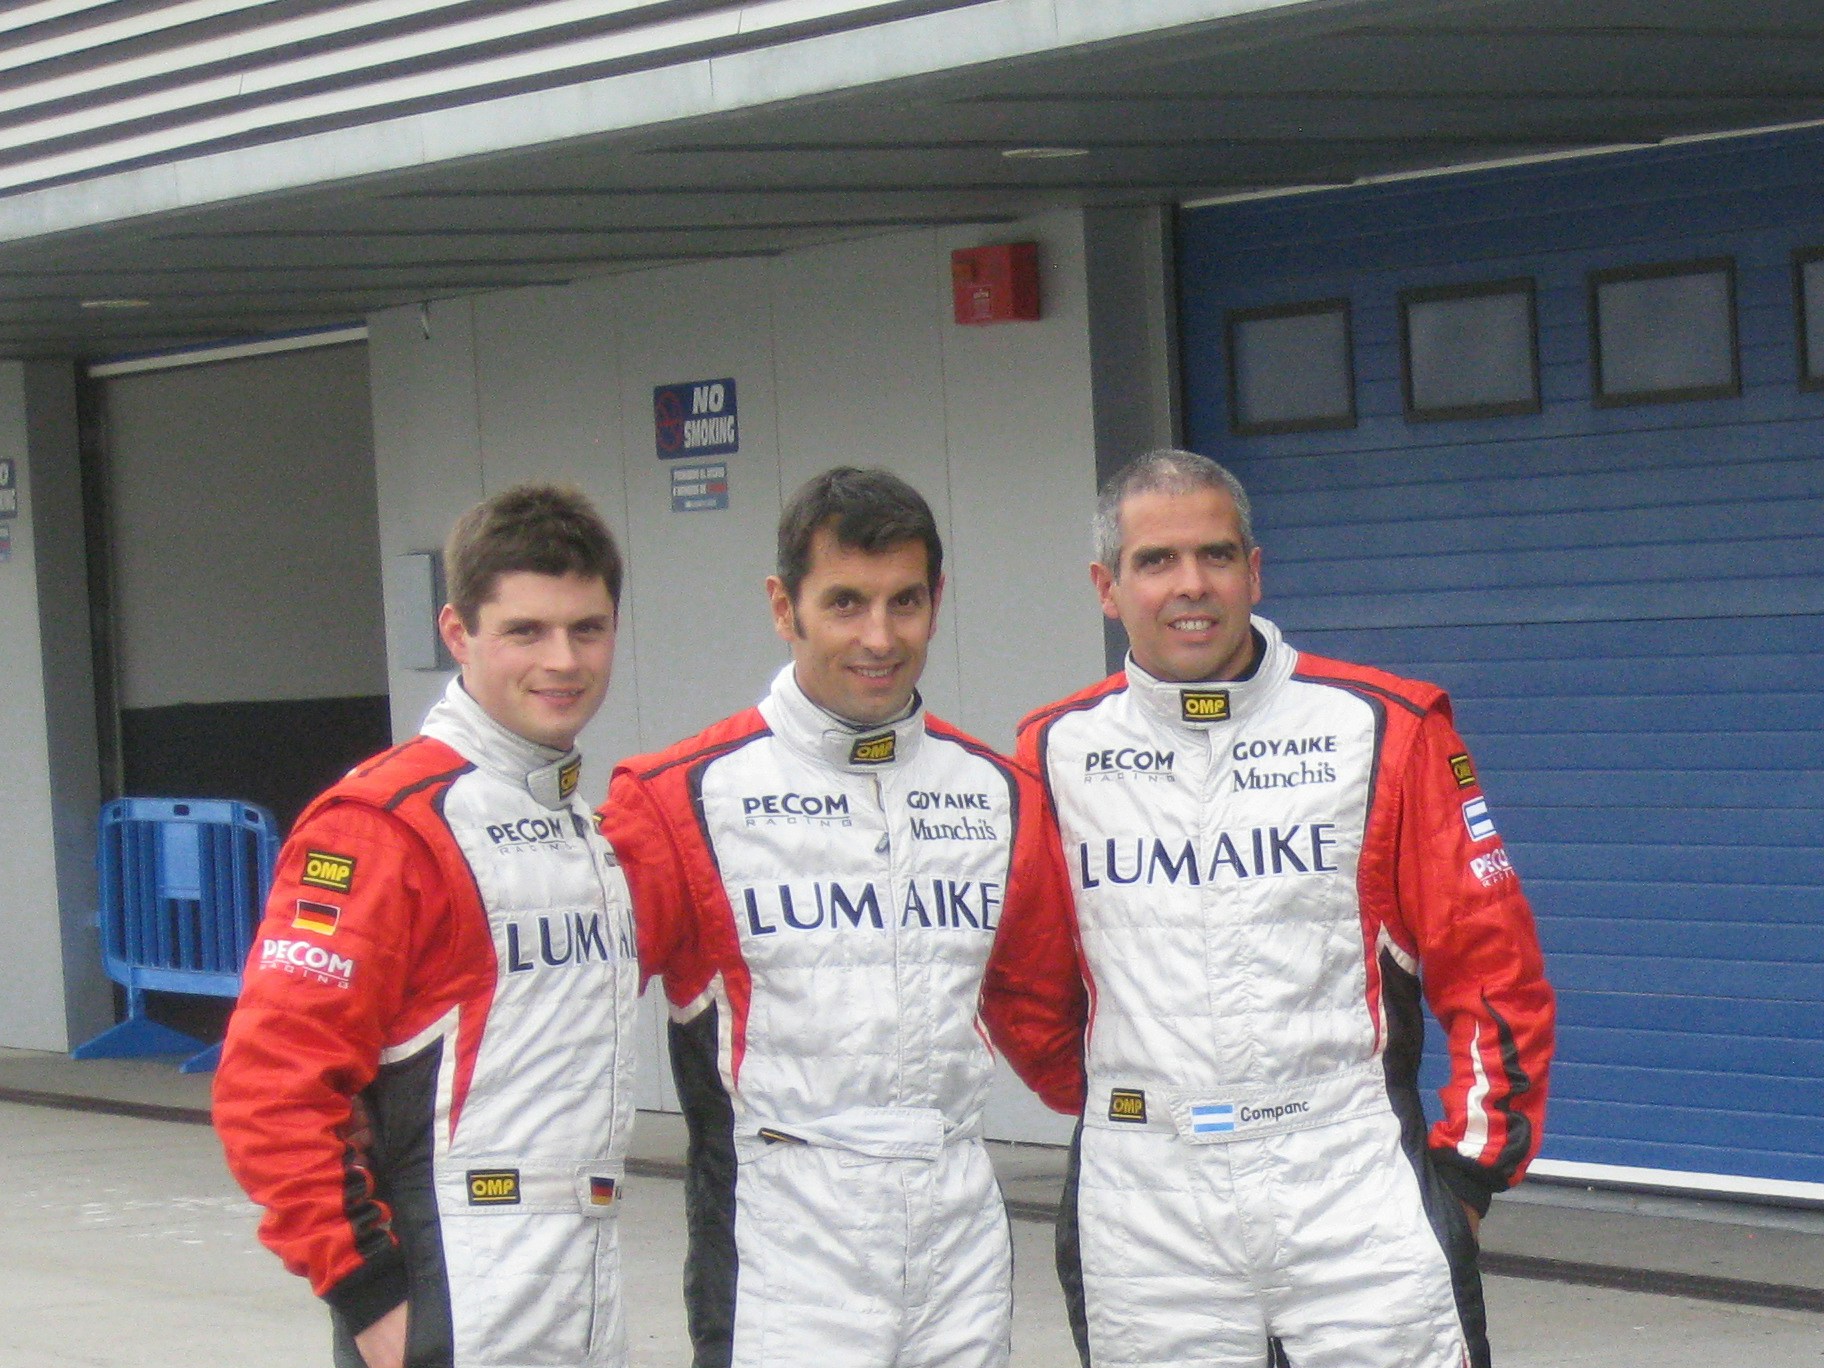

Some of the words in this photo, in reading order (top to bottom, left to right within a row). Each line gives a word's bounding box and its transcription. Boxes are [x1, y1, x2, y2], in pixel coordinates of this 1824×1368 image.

[692, 384, 725, 415] NO
[683, 415, 735, 449] SMOKING
[1186, 699, 1225, 714] OMP
[1085, 748, 1175, 771] PECOM
[1232, 735, 1337, 761] GOYAIKE
[1232, 760, 1337, 793] Munchi's
[742, 792, 849, 816] PECOM
[907, 790, 992, 810] GOYAIKE
[486, 817, 565, 844] PECOM
[910, 816, 998, 841] Munchi's
[1080, 823, 1338, 889] LUMAIKE
[306, 859, 351, 881] OMP
[743, 878, 1001, 936] LUMAIKE
[261, 939, 354, 978] PECOM
[1112, 1098, 1142, 1114] OMP
[1241, 1101, 1310, 1121] Companc
[471, 1179, 515, 1196] OMP
